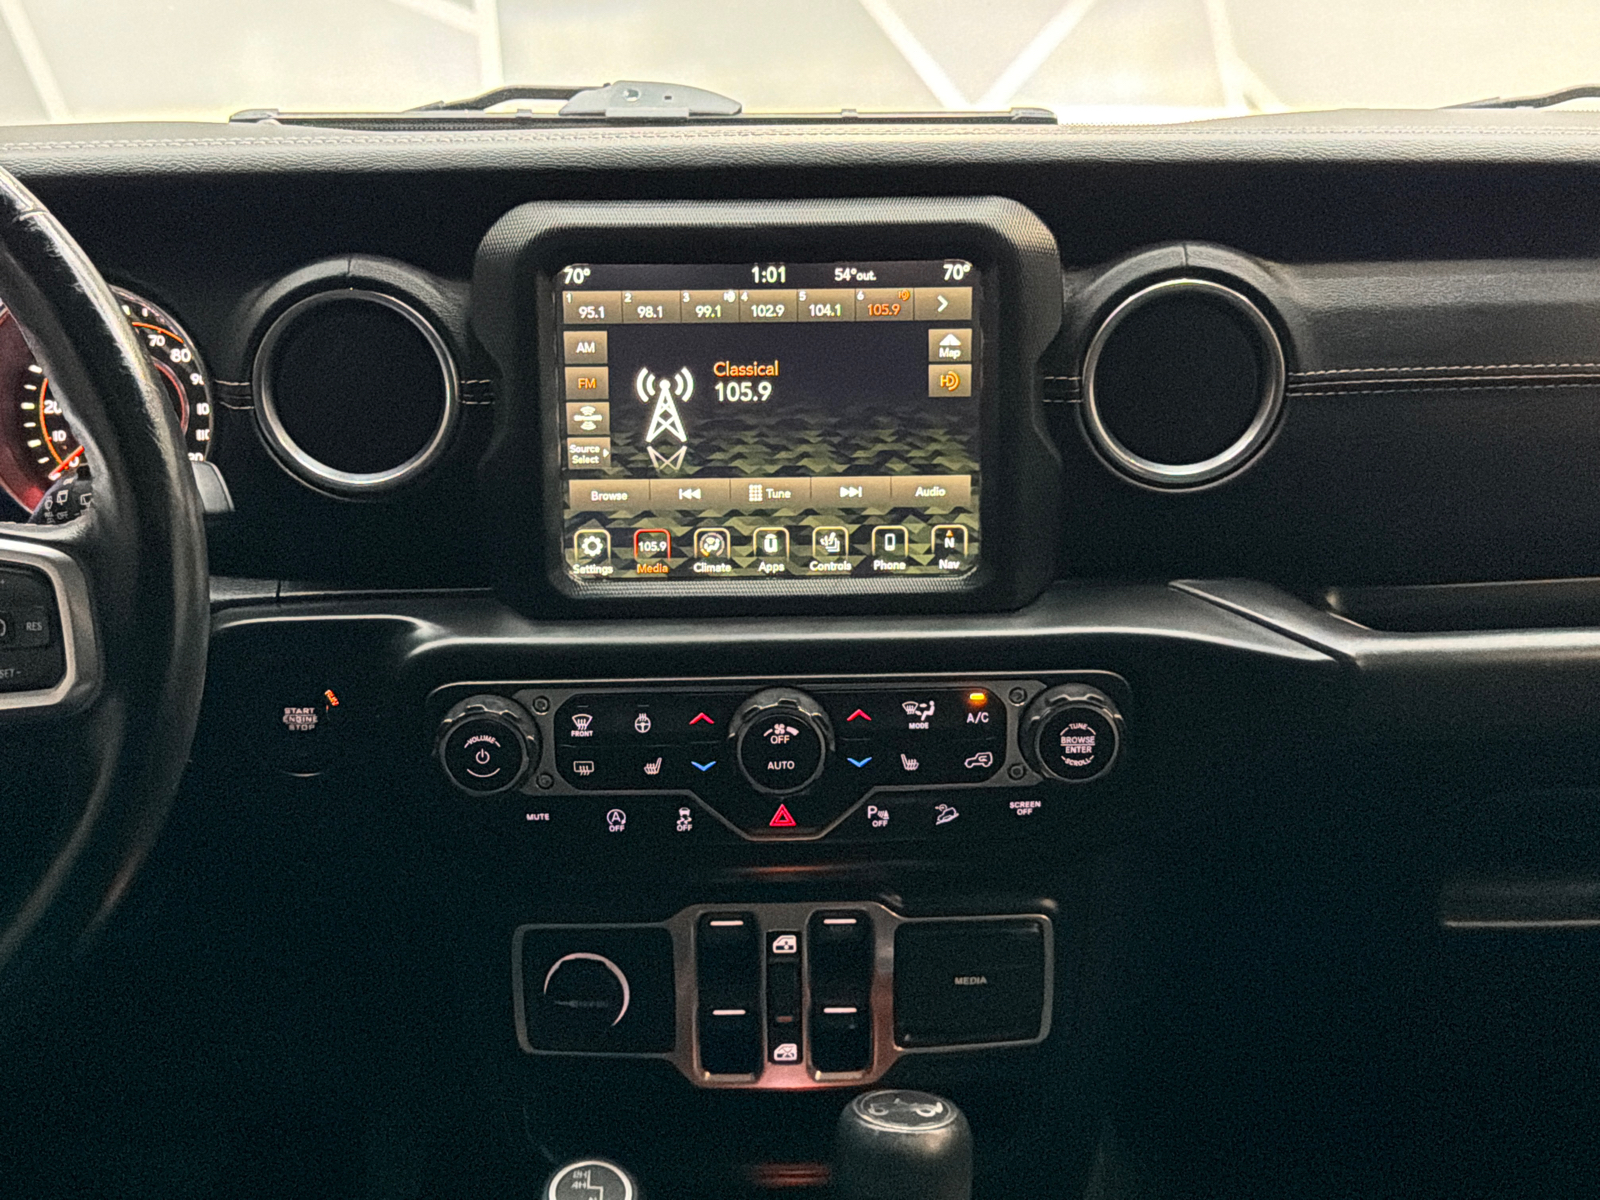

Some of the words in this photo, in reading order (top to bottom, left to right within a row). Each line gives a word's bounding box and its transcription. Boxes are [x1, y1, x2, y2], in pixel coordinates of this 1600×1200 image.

[751, 266, 786, 283] 1:01
[624, 292, 632, 303] 2
[682, 291, 690, 302] 3
[740, 291, 748, 302] 4
[798, 291, 806, 301] 5
[856, 290, 864, 300] 6
[578, 305, 605, 319] 95.1
[637, 305, 664, 319] 98.1
[695, 304, 721, 318] 99.1
[751, 304, 785, 318] 102.9
[809, 303, 841, 317] 104.1
[867, 303, 901, 317] 105.9
[147, 334, 166, 347] 70
[576, 342, 596, 354] AM
[938, 346, 962, 360] Map
[170, 348, 192, 363] 80
[713, 360, 780, 377] Classical
[577, 377, 597, 389] FM
[714, 381, 773, 402] 105.9
[569, 444, 601, 454] Source
[572, 455, 600, 465] Select
[590, 490, 629, 502] Browse
[765, 487, 792, 500] Tune
[915, 486, 947, 498] Audio
[638, 541, 667, 553] 105.9
[573, 563, 614, 576] Settings
[636, 562, 669, 574] Media
[693, 561, 733, 574] Climate
[758, 561, 786, 574] Apps
[809, 559, 853, 572] Controls
[873, 558, 907, 572] Phone
[938, 557, 960, 571] Nav
[26, 621, 43, 632] RES
[966, 713, 990, 724] A/C
[908, 722, 930, 730] MODE
[467, 735, 497, 745] VOLUME
[770, 734, 791, 745] OFF
[1060, 735, 1096, 744] BROWSE
[1065, 745, 1093, 754] ENTER
[767, 760, 796, 770] AUTO
[1009, 800, 1042, 809] SCREEN
[526, 812, 550, 821] MUTE
[1016, 808, 1034, 816] OFF
[608, 823, 626, 833] OFF
[676, 823, 693, 832] OFF
[872, 819, 889, 828] OFF
[954, 975, 989, 986] MEDIA
